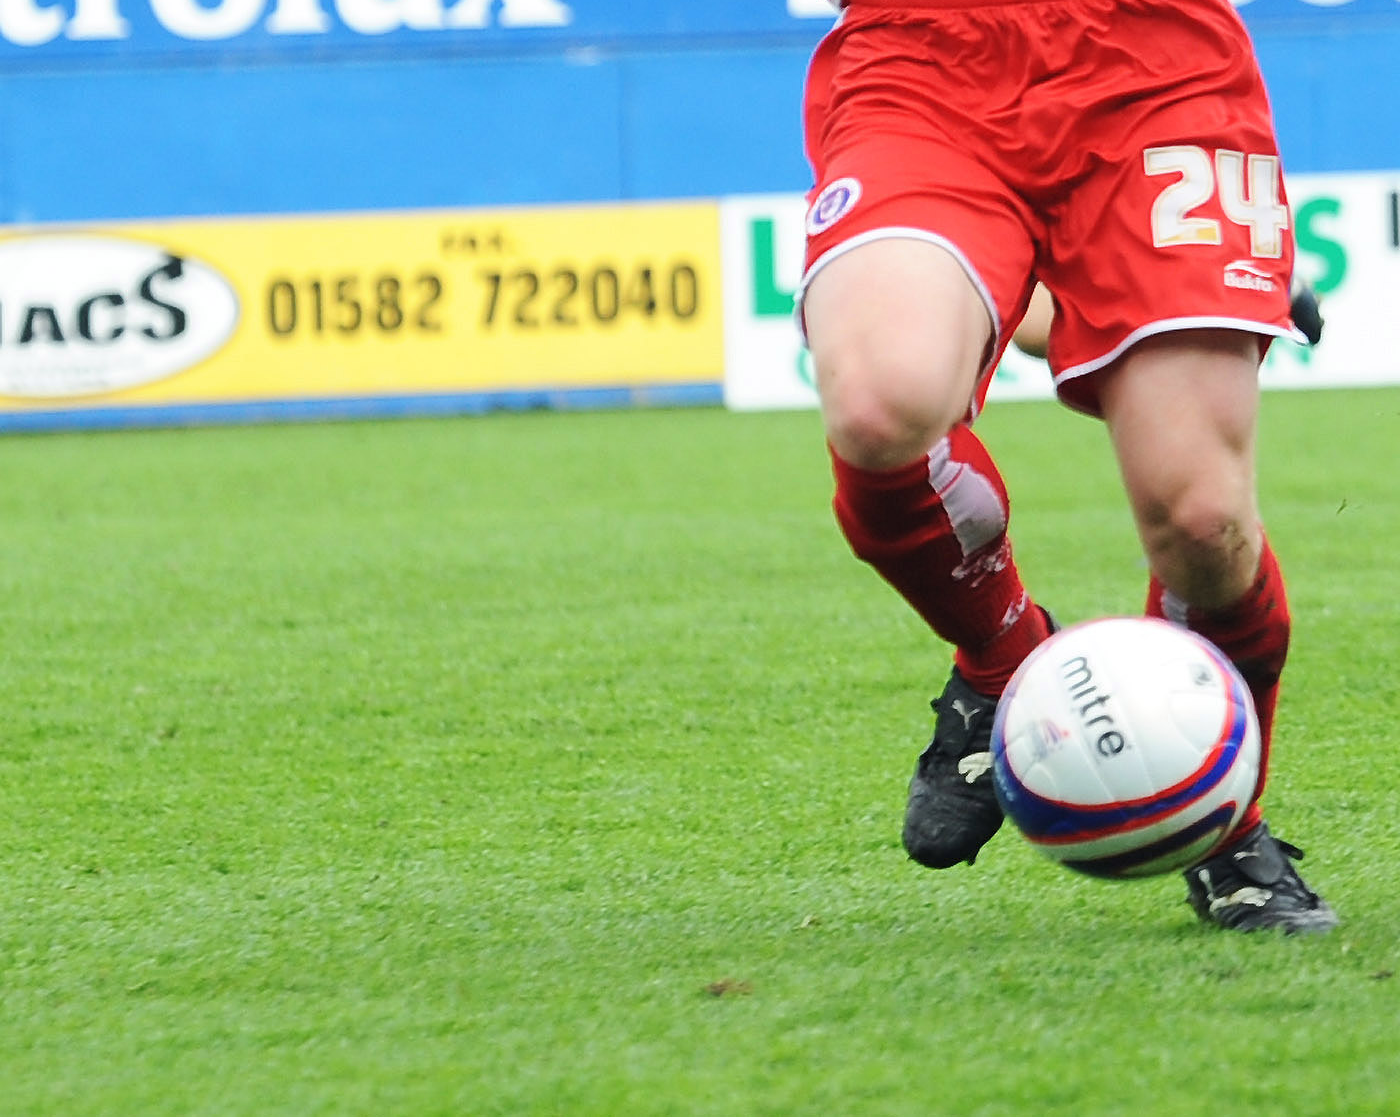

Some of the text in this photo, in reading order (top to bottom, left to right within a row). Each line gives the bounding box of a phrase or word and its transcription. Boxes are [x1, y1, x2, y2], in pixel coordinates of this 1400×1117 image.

[1143, 145, 1289, 259] 24
[267, 275, 443, 337] 01582
[481, 265, 698, 329] 722040
[1061, 656, 1126, 757] mitre
